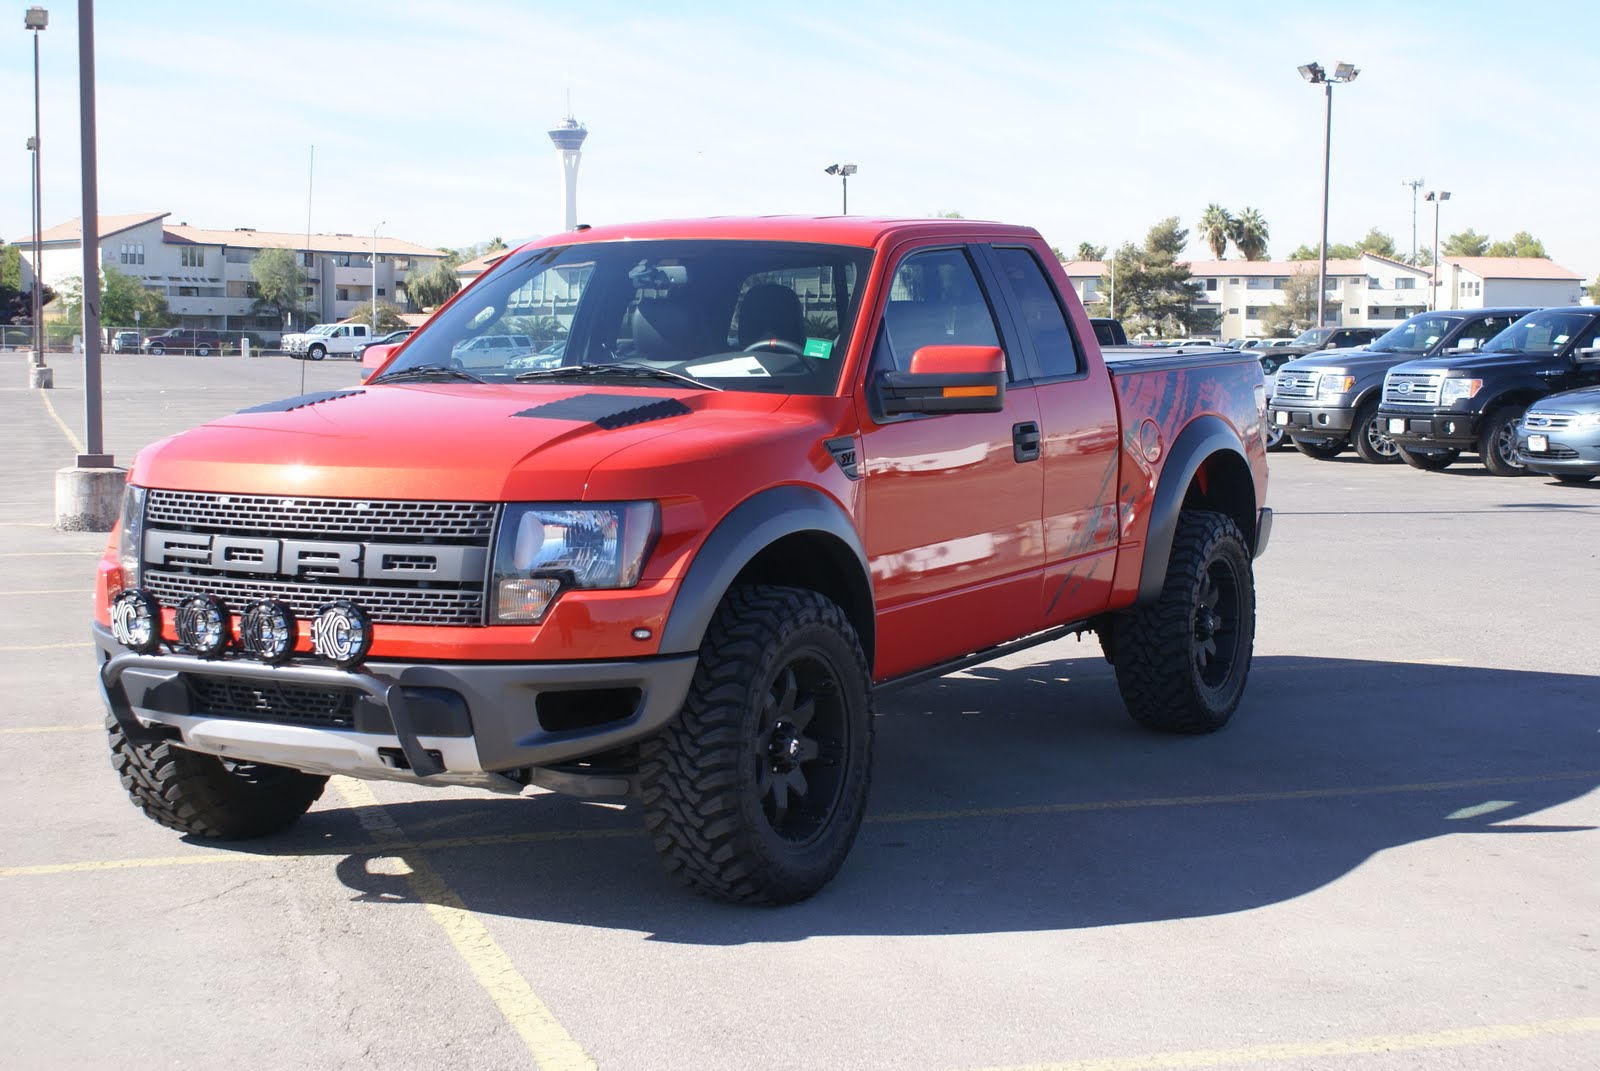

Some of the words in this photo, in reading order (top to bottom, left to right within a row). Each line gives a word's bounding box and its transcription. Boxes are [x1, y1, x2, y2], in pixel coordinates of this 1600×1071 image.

[144, 528, 488, 582] FORD
[111, 600, 137, 645] KC
[176, 606, 208, 647] KC
[241, 609, 274, 653] KC
[314, 612, 351, 659] KC
